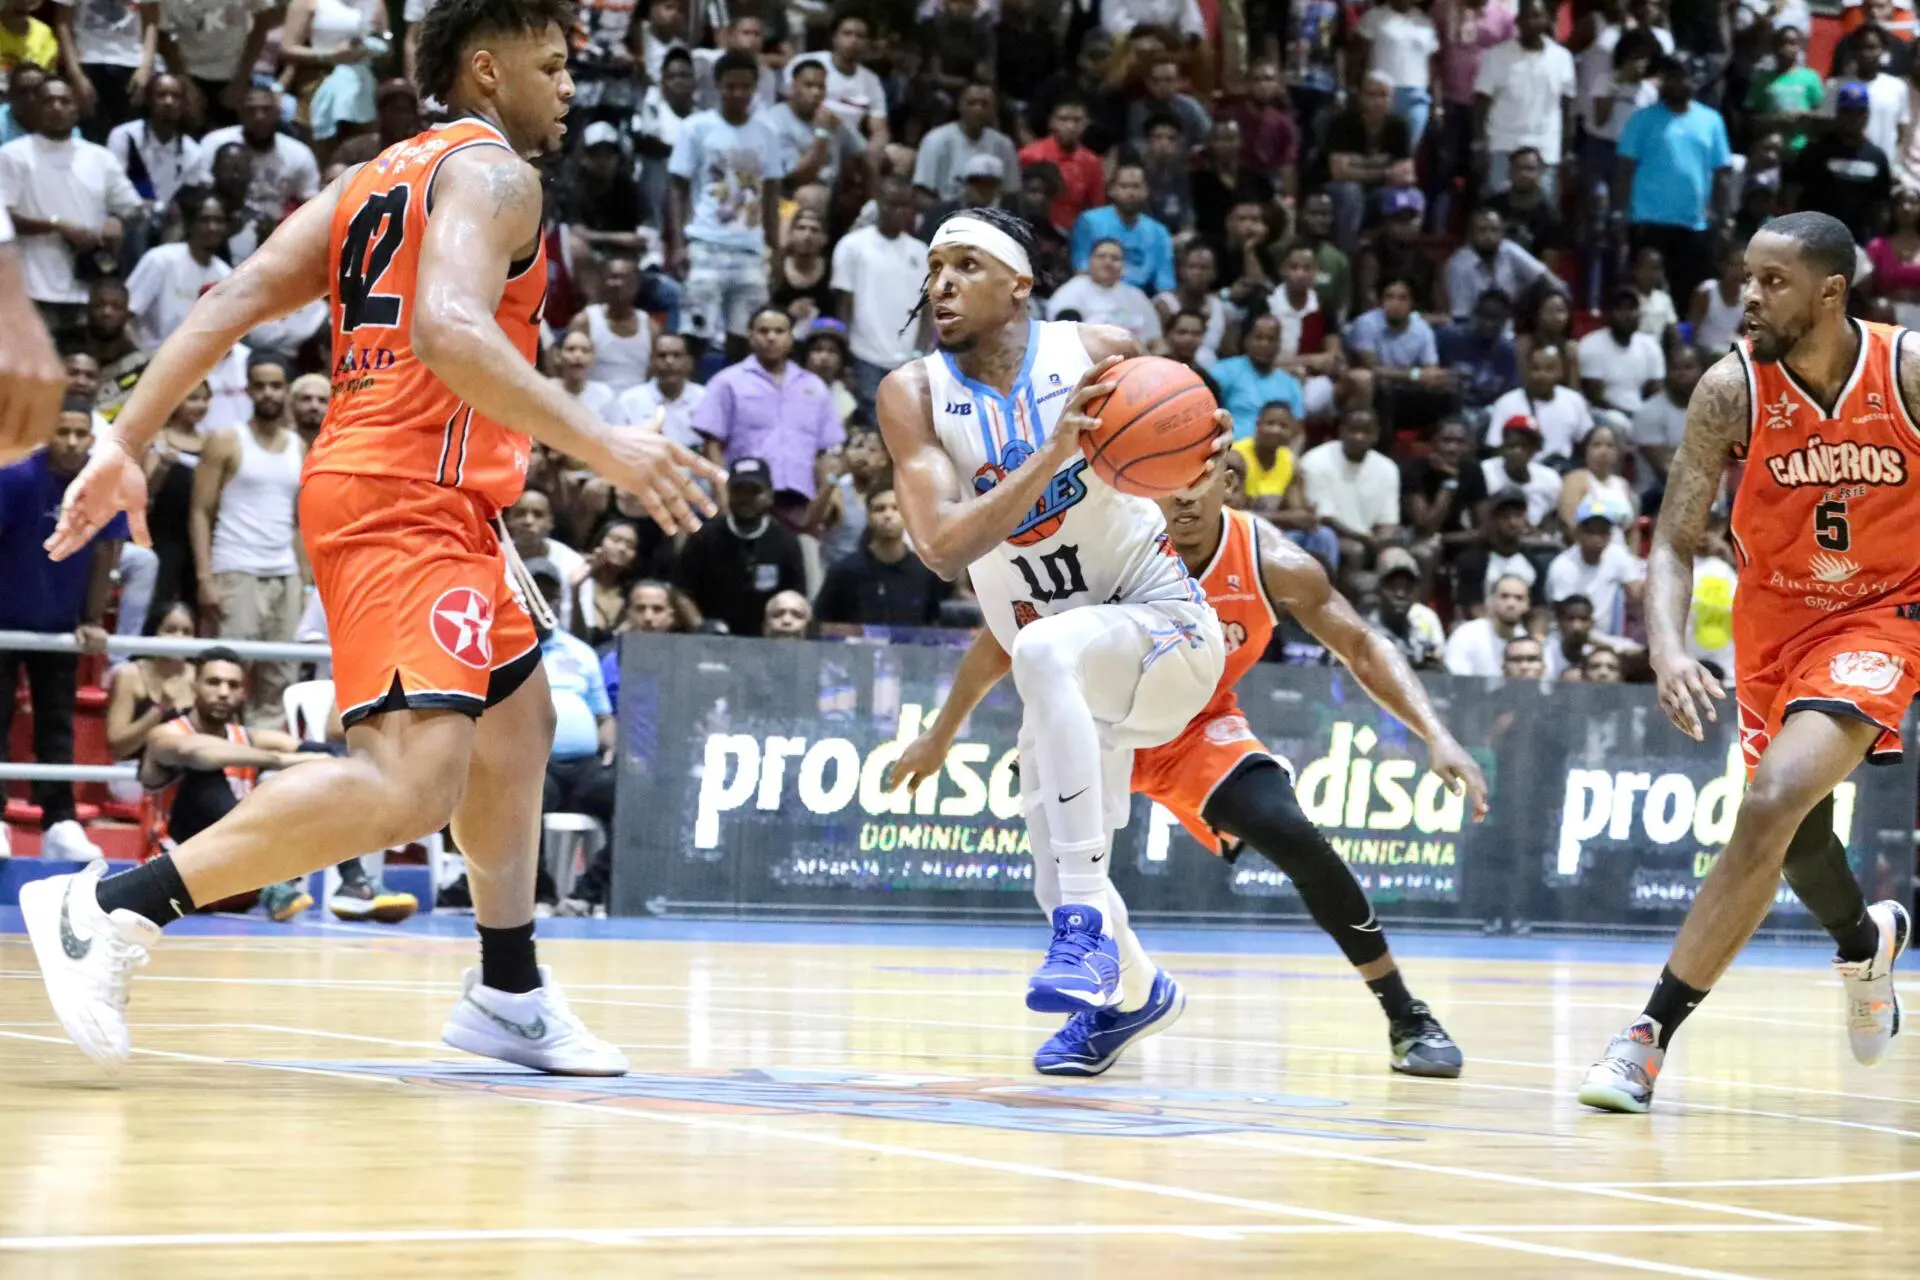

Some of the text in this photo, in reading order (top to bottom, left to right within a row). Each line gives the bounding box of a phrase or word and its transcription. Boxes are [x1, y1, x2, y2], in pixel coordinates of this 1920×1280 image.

[339, 184, 412, 335] 42
[1767, 434, 1907, 487] CAÑEROS
[1814, 500, 1851, 553] 5
[1010, 544, 1087, 604] 10
[1770, 570, 1900, 597] PUNTACAN
[860, 823, 1032, 854] DOMINICANA
[1327, 836, 1456, 866] MINICANA
